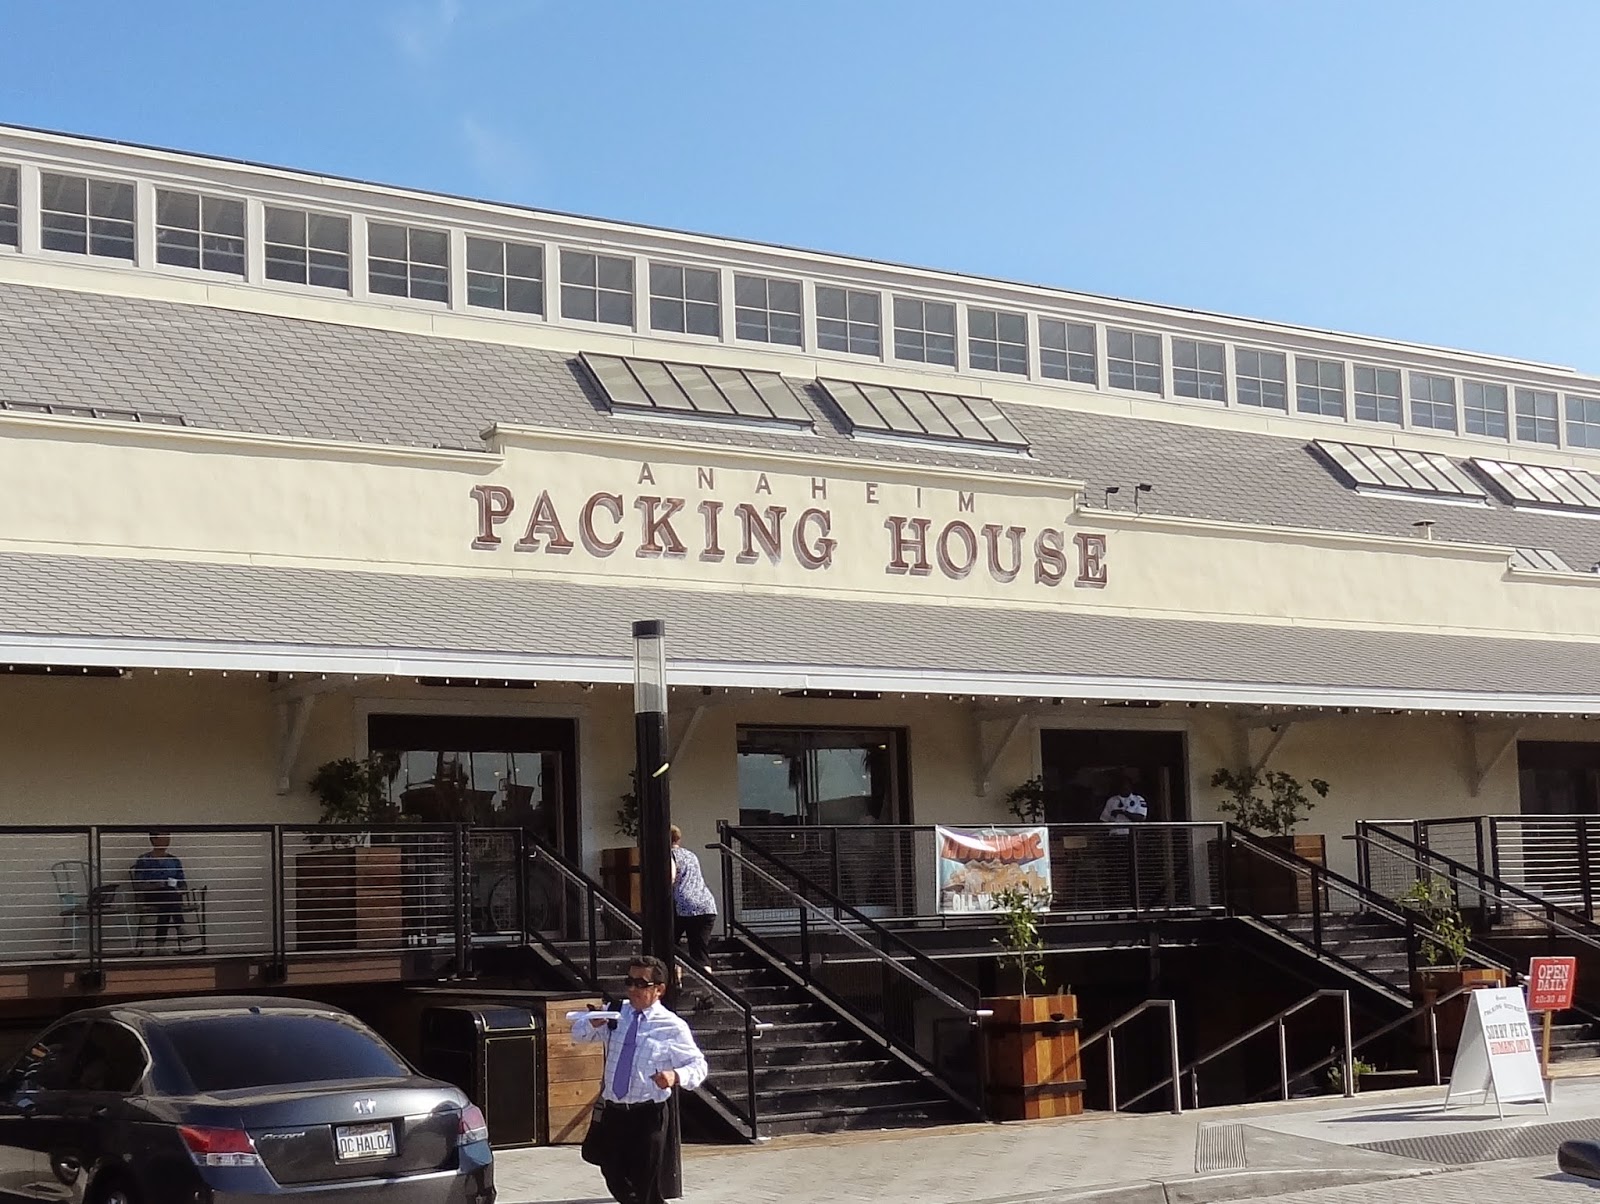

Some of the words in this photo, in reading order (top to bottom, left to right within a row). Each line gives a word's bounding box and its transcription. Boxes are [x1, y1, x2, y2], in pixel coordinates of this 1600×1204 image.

[637, 462, 976, 514] ANAHEIM
[470, 484, 838, 571] PACKING
[884, 515, 1109, 589] HOUSE
[982, 833, 1044, 859] MUSIC
[1538, 964, 1570, 979] OPEN
[1536, 979, 1568, 991] DAILY
[1485, 1023, 1508, 1039] SORRY
[1509, 1022, 1529, 1037] PETS
